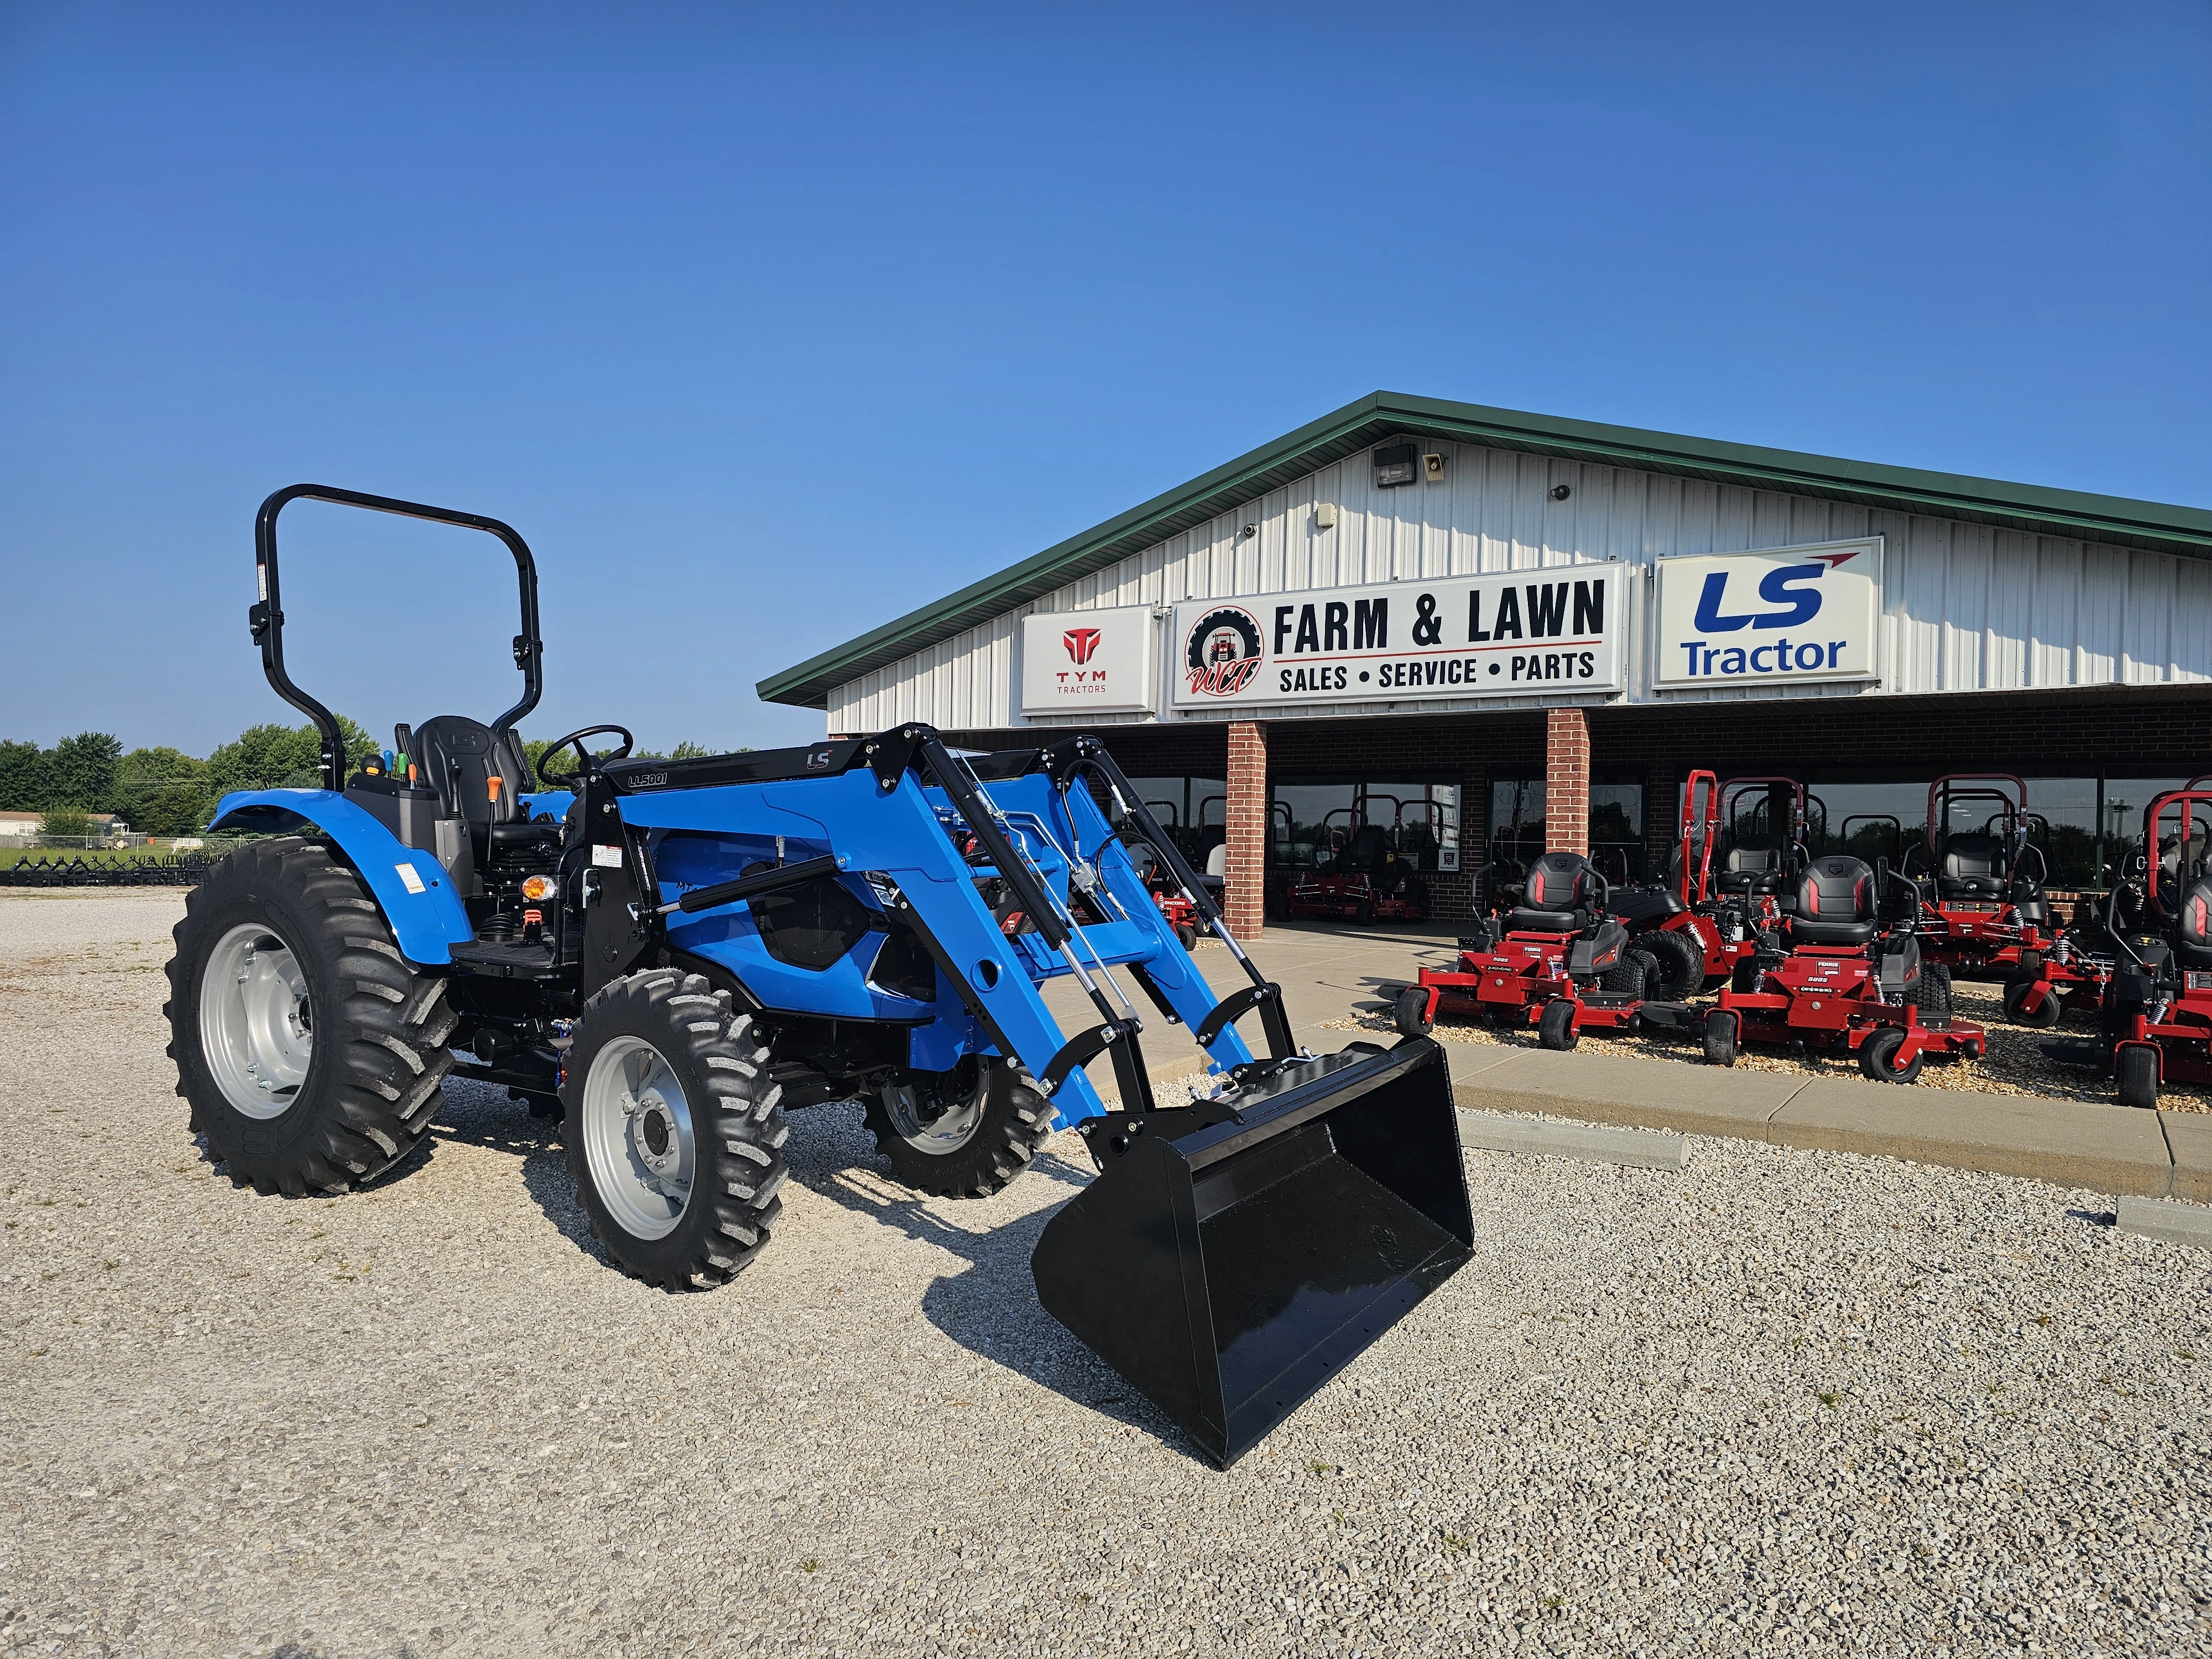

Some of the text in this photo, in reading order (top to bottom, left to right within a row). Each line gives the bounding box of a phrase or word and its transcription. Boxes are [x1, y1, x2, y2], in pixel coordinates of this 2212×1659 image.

[1694, 563, 1825, 633] LS
[1274, 579, 1604, 654] FARM & LAWN
[1280, 651, 1594, 692] SALES SERVICE PARTS
[1680, 638, 1846, 676] Tractor
[1056, 671, 1105, 682] TYM
[1057, 685, 1105, 693] TRACTORS
[1185, 658, 1261, 694] WCT
[807, 752, 829, 769] LS
[628, 773, 667, 787] LL5001
